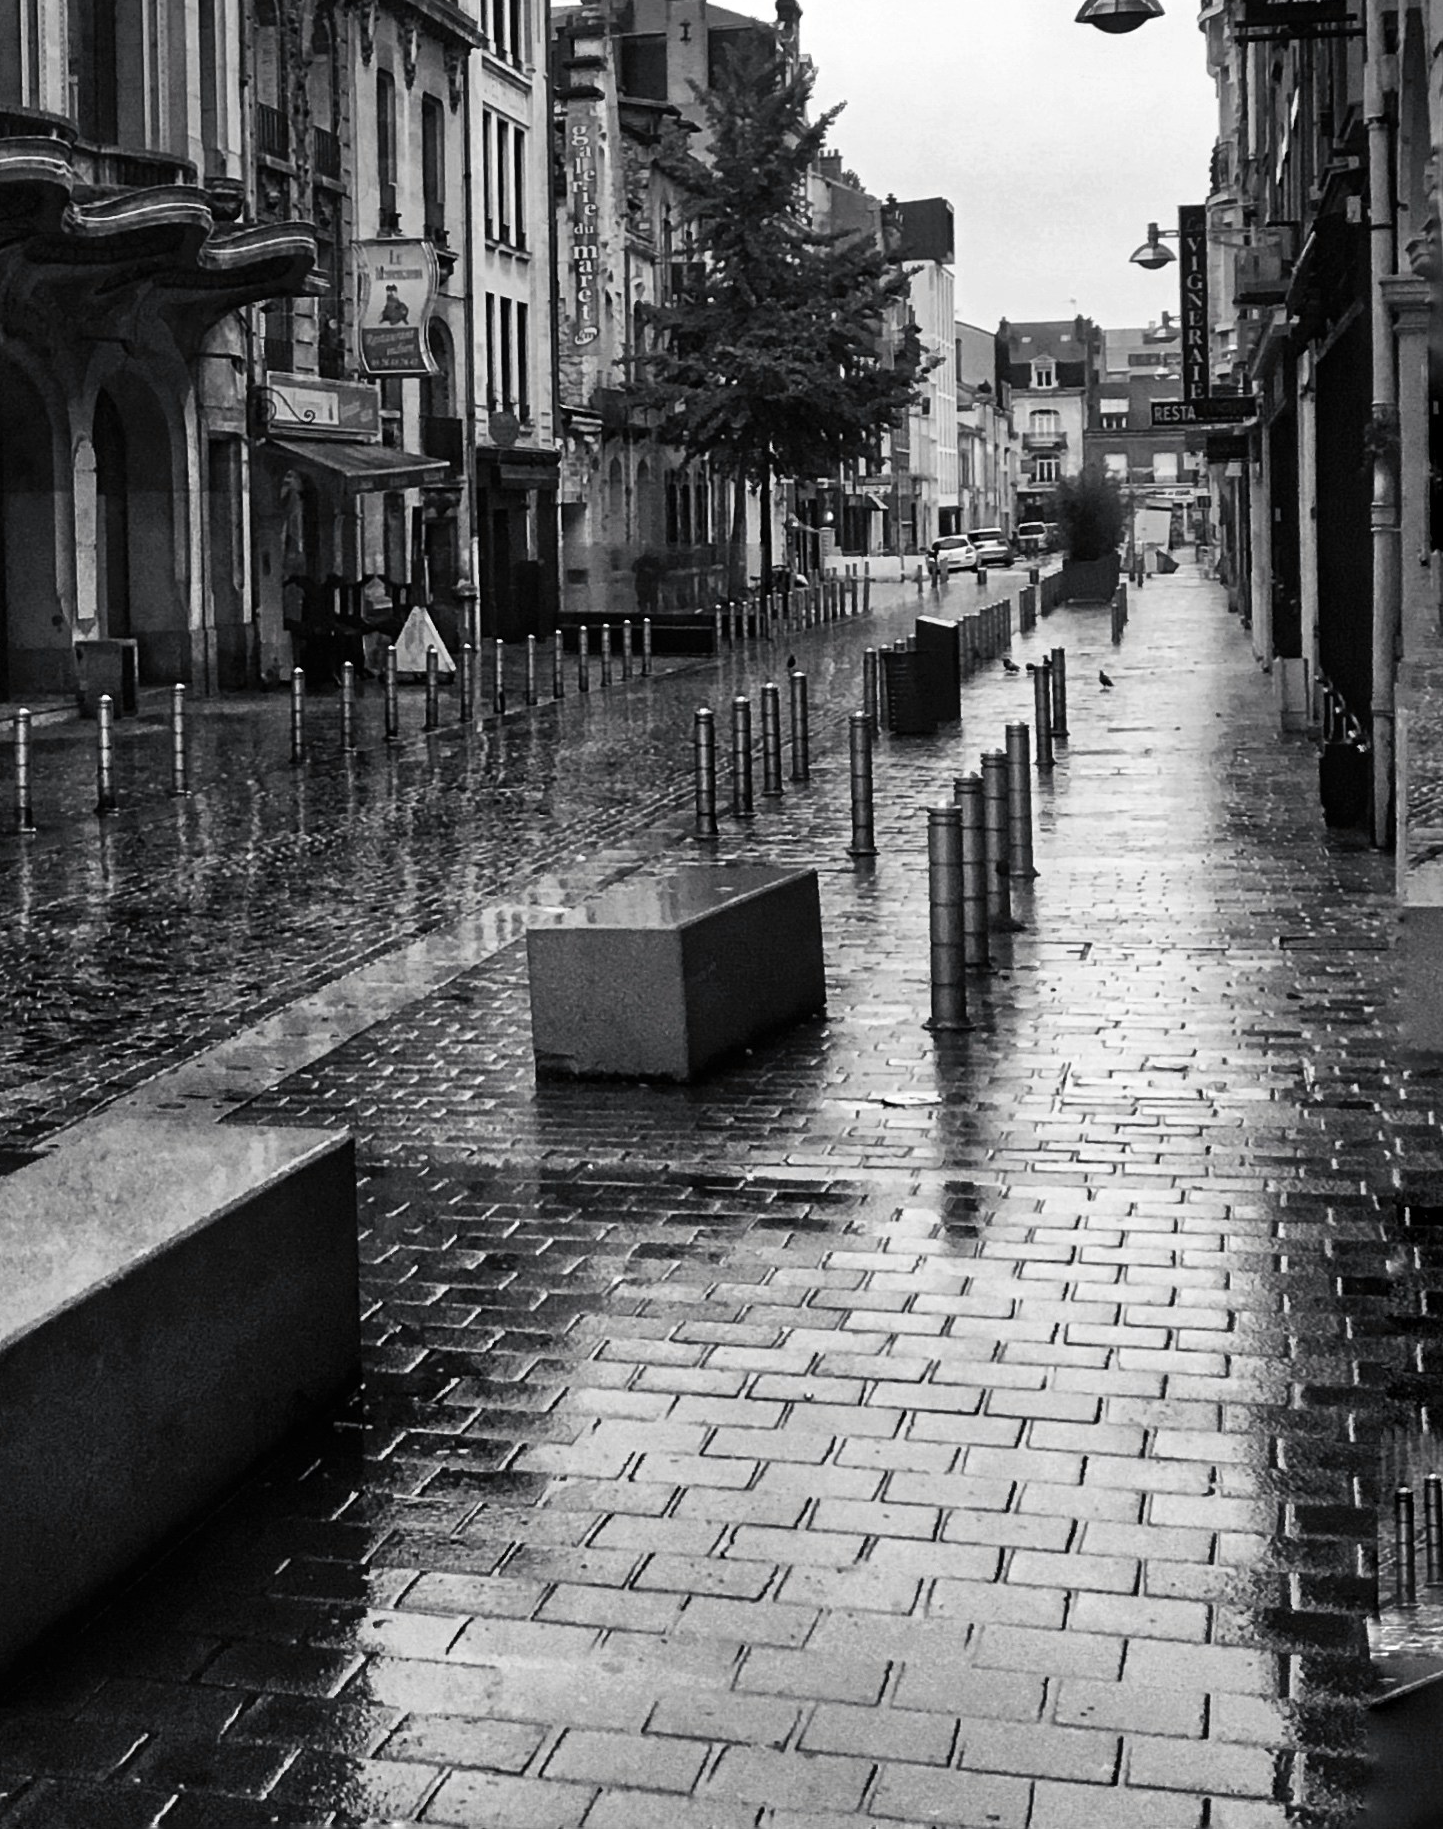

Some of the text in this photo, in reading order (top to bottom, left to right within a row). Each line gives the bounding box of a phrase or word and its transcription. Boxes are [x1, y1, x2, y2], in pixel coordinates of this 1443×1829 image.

[571, 124, 598, 320] galerie du maret
[1186, 236, 1205, 399] VIGNERAIE
